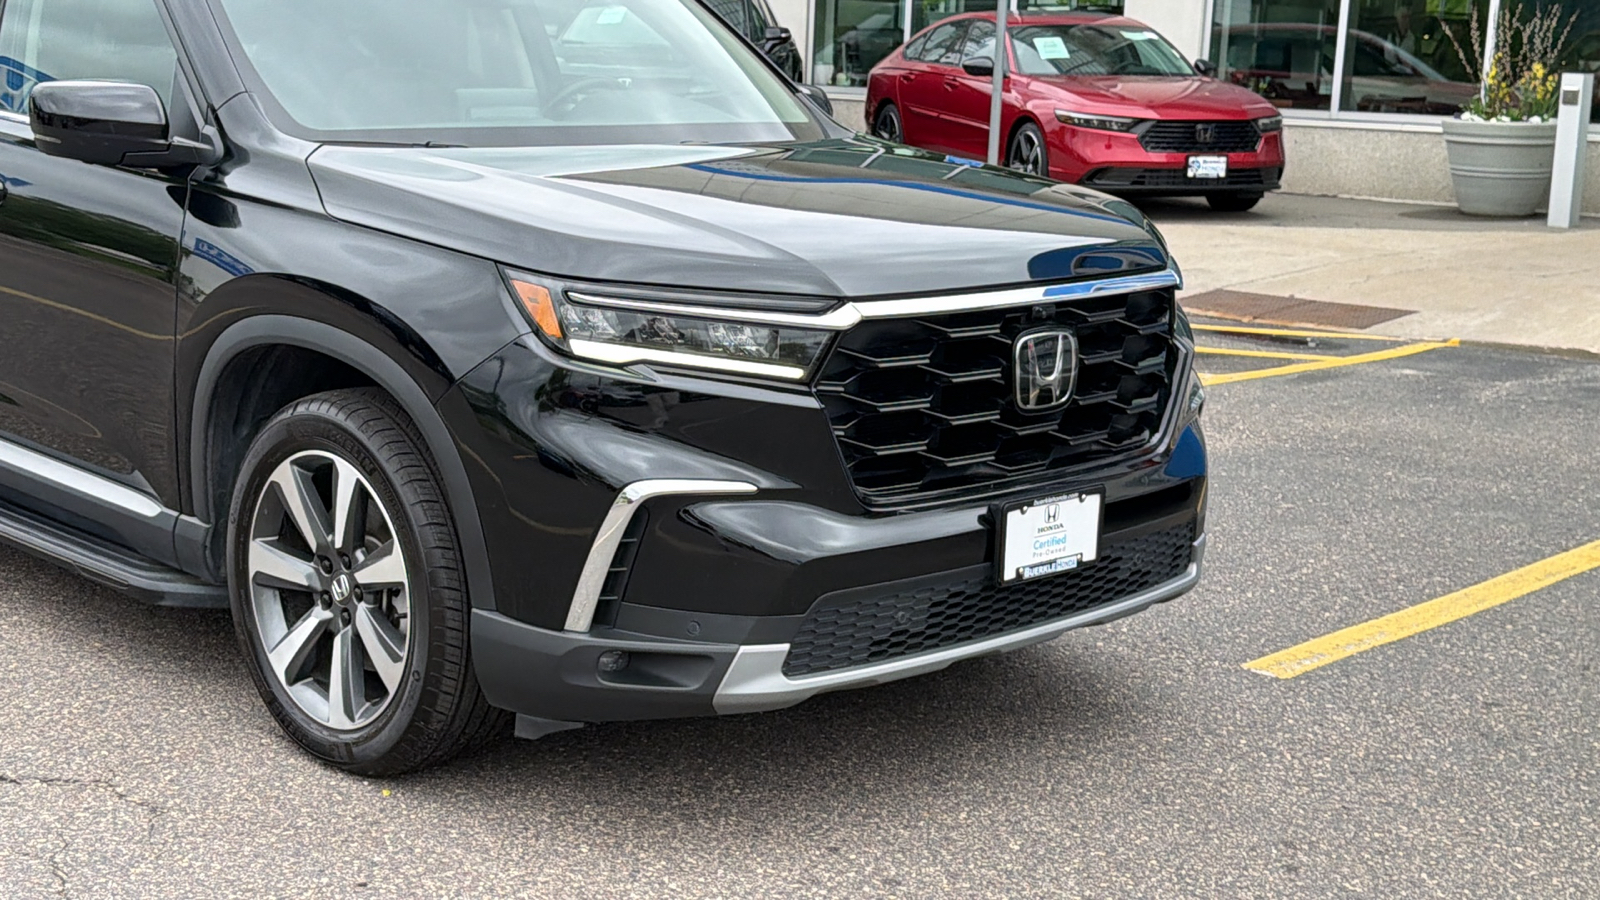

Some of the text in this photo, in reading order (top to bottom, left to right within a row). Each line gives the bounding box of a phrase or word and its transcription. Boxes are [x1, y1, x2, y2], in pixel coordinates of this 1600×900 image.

[1038, 523, 1064, 533] HONDA
[1034, 534, 1066, 550] Certified
[1033, 547, 1066, 557] Pre-Owned
